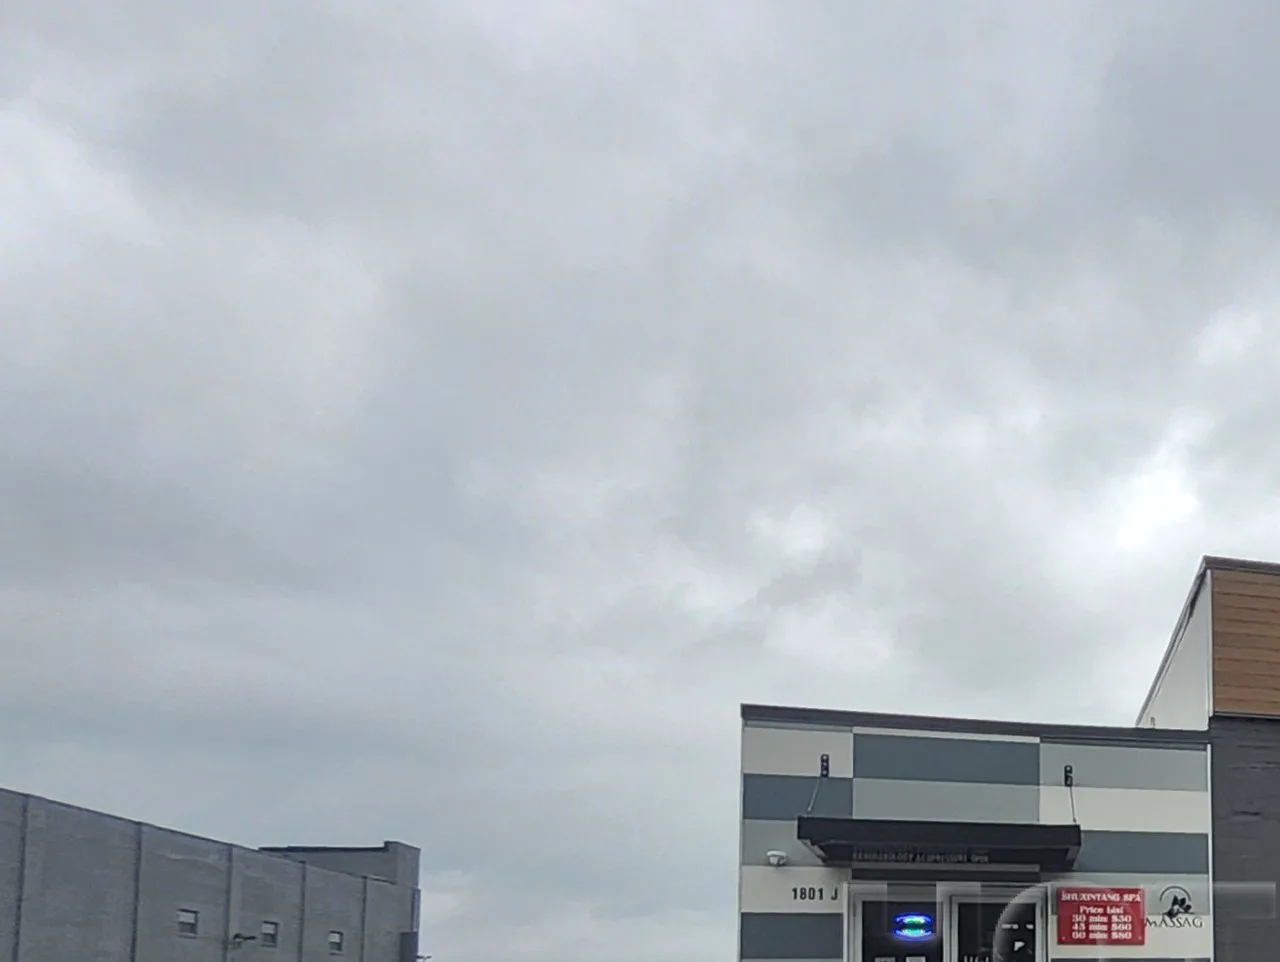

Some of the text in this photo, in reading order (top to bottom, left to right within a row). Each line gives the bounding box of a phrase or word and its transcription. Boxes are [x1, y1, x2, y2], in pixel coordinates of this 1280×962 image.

[792, 887, 838, 901] 1801 J
[1061, 892, 1142, 902] SHUXINTANG SPA
[1079, 905, 1104, 914] Price
